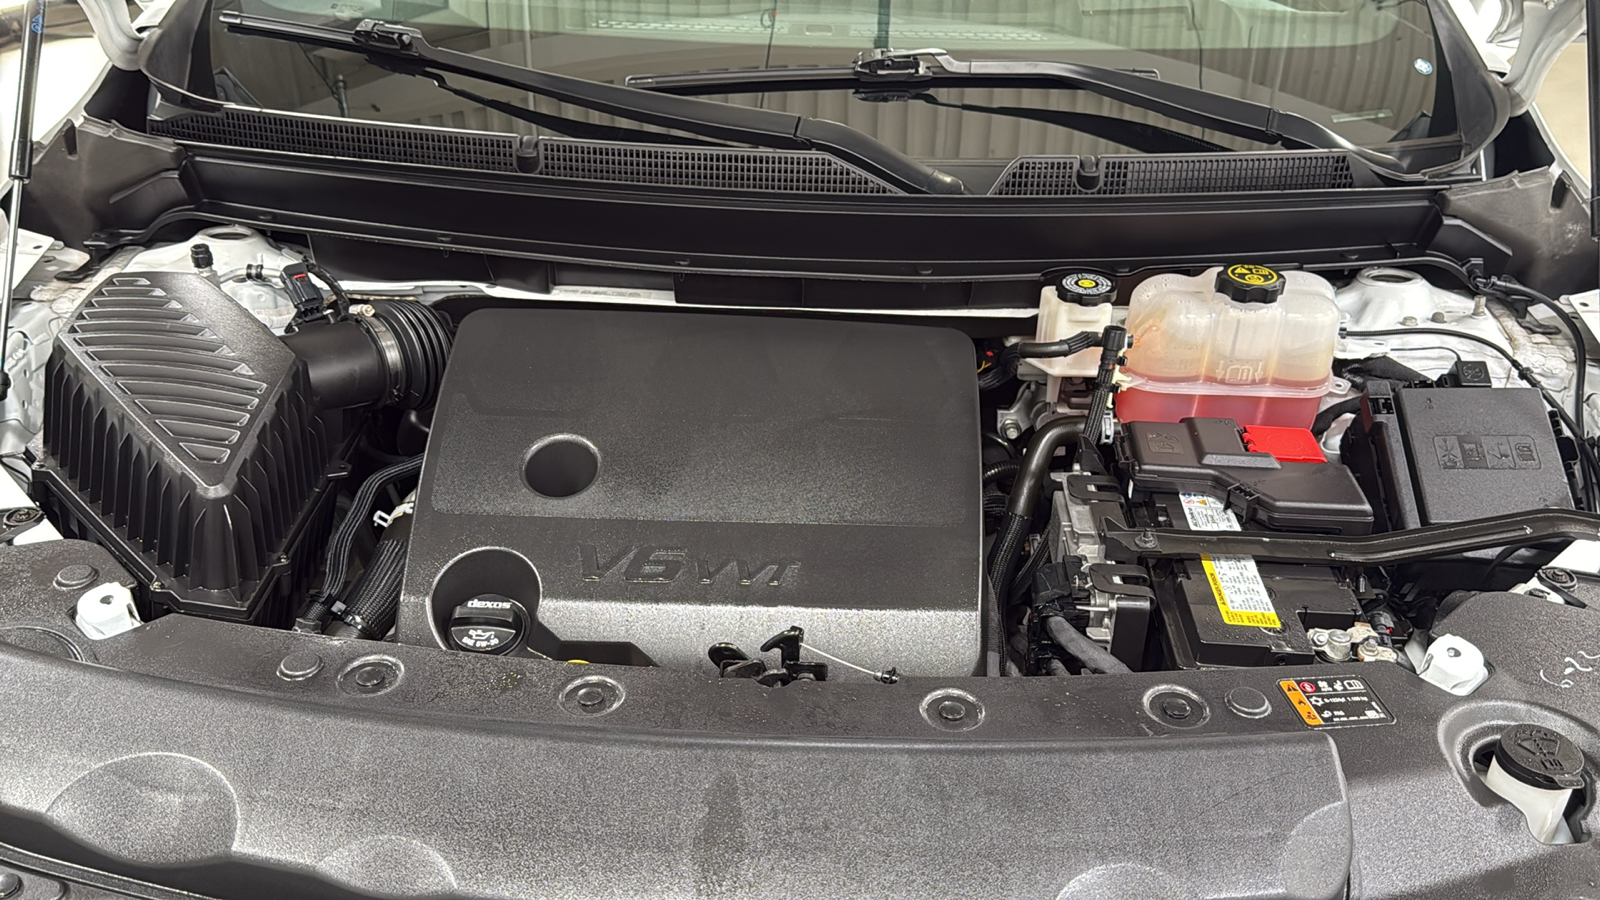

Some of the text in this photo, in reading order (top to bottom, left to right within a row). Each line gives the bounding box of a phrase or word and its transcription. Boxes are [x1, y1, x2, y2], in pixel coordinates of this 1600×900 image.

[578, 545, 801, 586] V6 VVT
[467, 599, 512, 609] dexos
